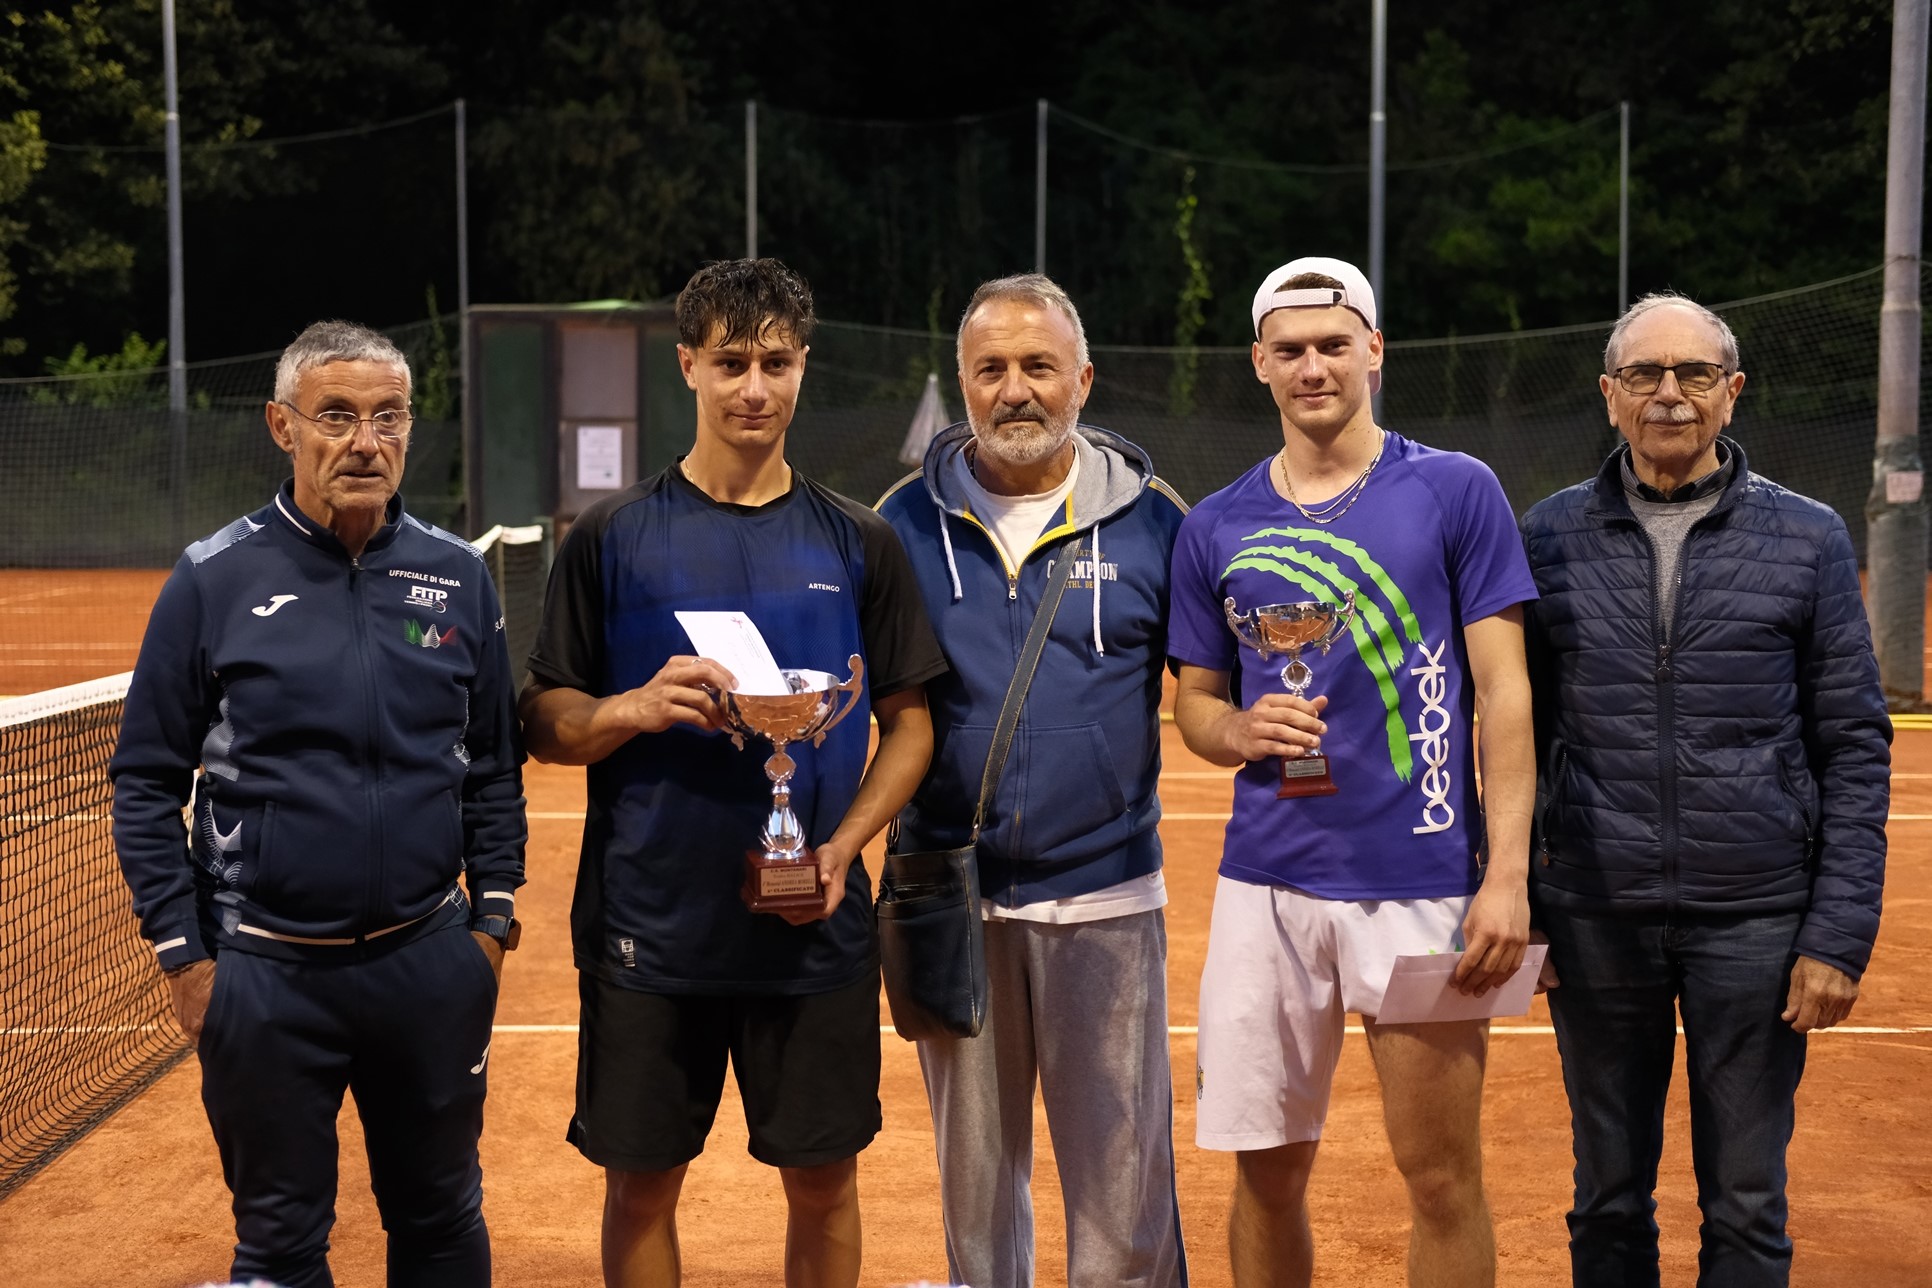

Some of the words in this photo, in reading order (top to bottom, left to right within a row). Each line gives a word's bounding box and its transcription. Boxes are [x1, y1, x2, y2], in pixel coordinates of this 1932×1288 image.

[389, 569, 428, 582] UFFICIALE
[429, 575, 438, 584] DI
[439, 577, 461, 588] GARA
[1046, 560, 1119, 581] CMPON
[411, 585, 448, 601] FITP
[808, 582, 841, 593] ARTENGO
[1409, 639, 1455, 835] beebek
